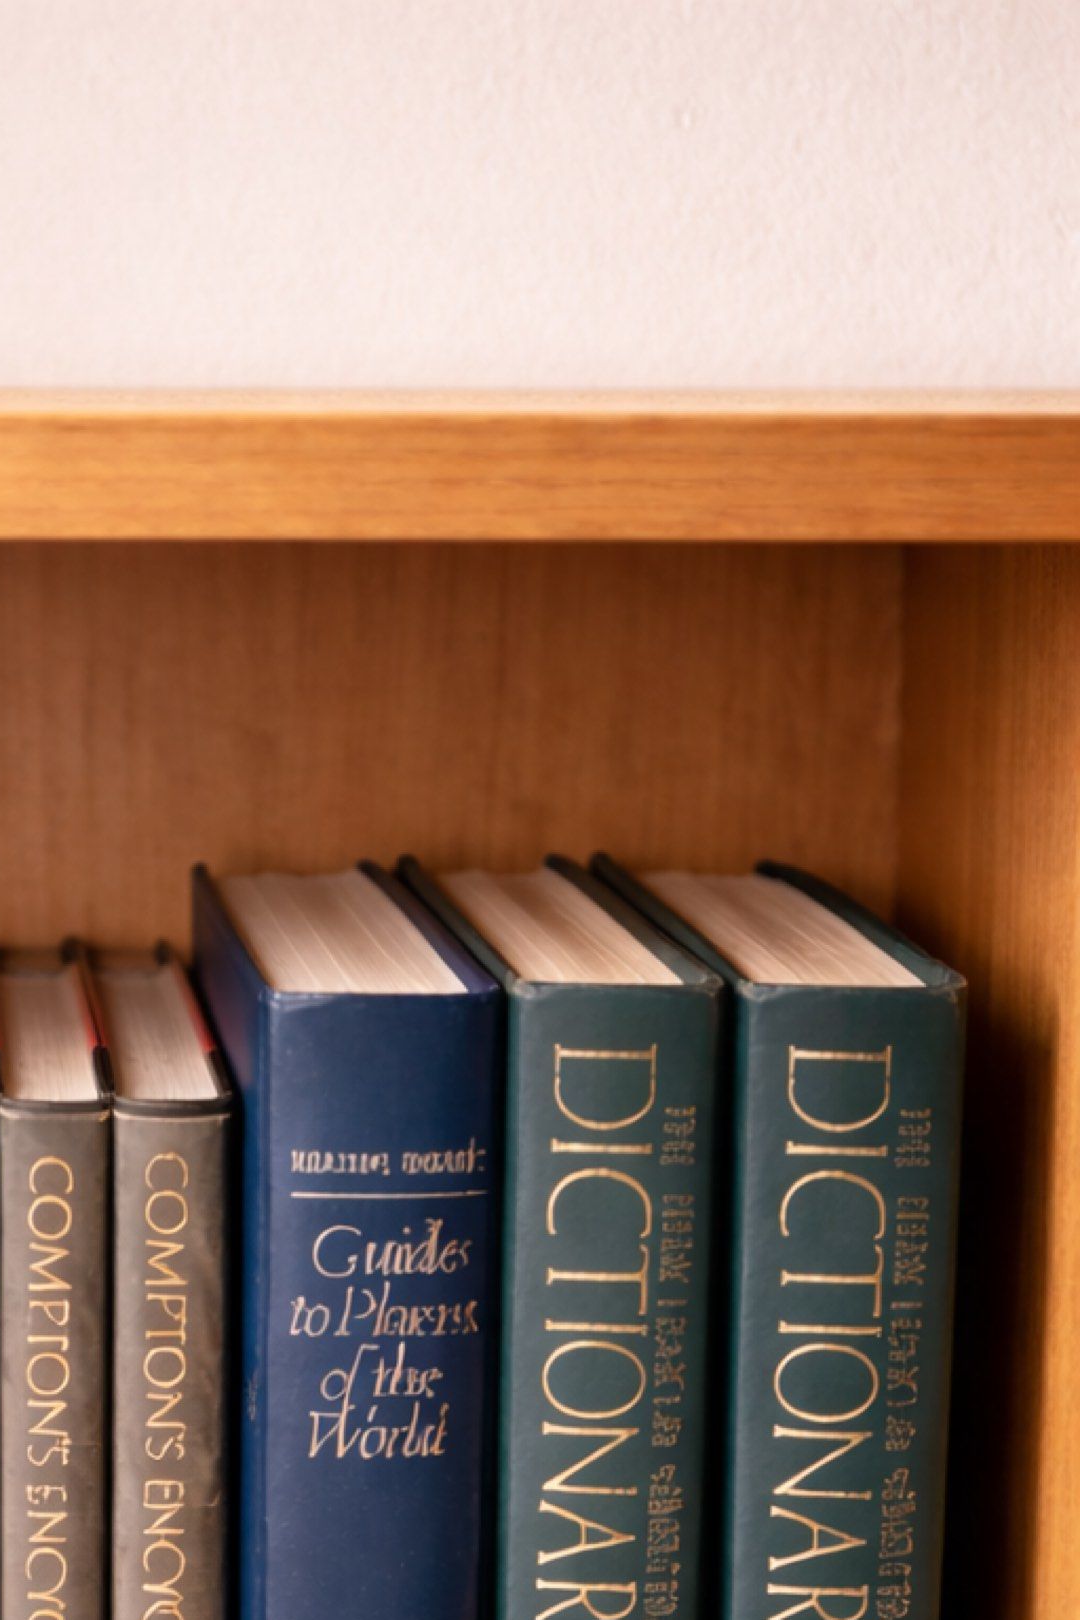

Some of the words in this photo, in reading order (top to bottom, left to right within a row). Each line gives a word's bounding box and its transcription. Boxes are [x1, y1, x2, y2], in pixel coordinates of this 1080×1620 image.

[290, 1296, 330, 1337] to
[321, 1344, 379, 1410] of
[308, 1402, 449, 1458] World
